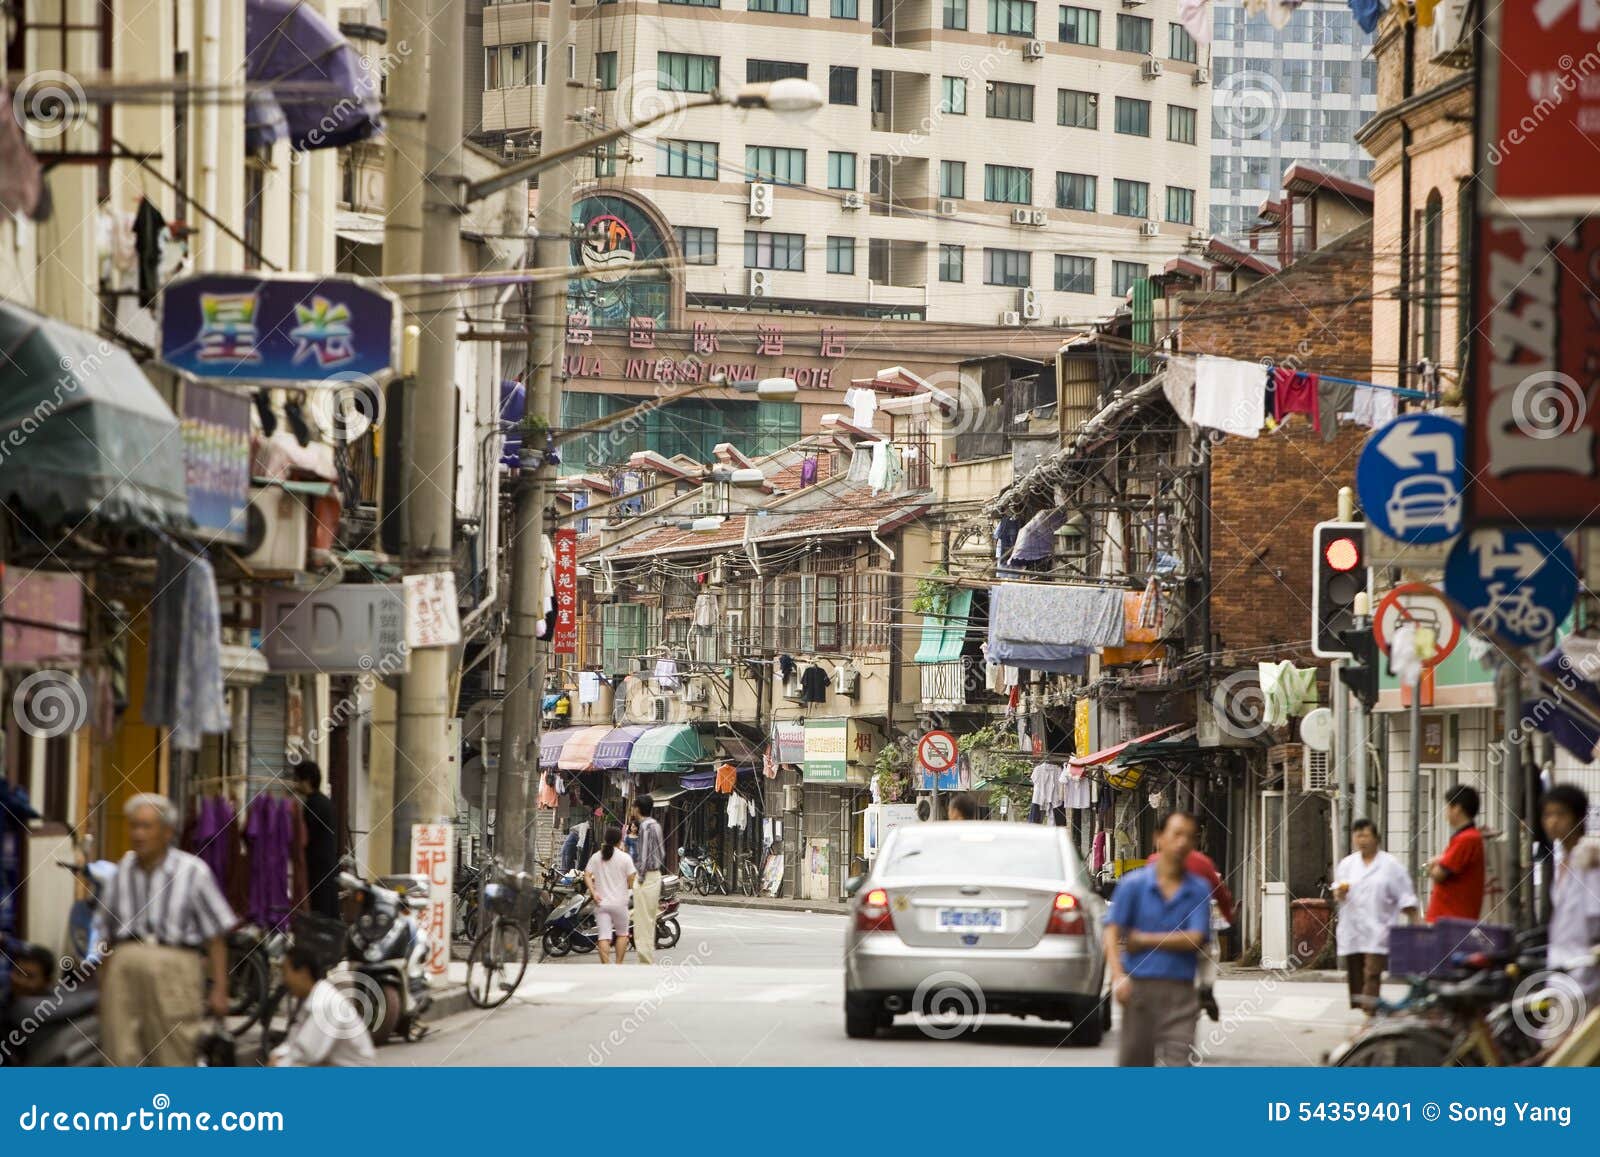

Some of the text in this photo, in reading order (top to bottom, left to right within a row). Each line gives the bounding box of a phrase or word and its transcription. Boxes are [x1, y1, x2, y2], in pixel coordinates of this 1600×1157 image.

[625, 358, 759, 384] INTERNATIONAL
[783, 366, 836, 389] HOTEL
[558, 537, 574, 624] 金帝苑浴室
[854, 732, 872, 752] 烟
